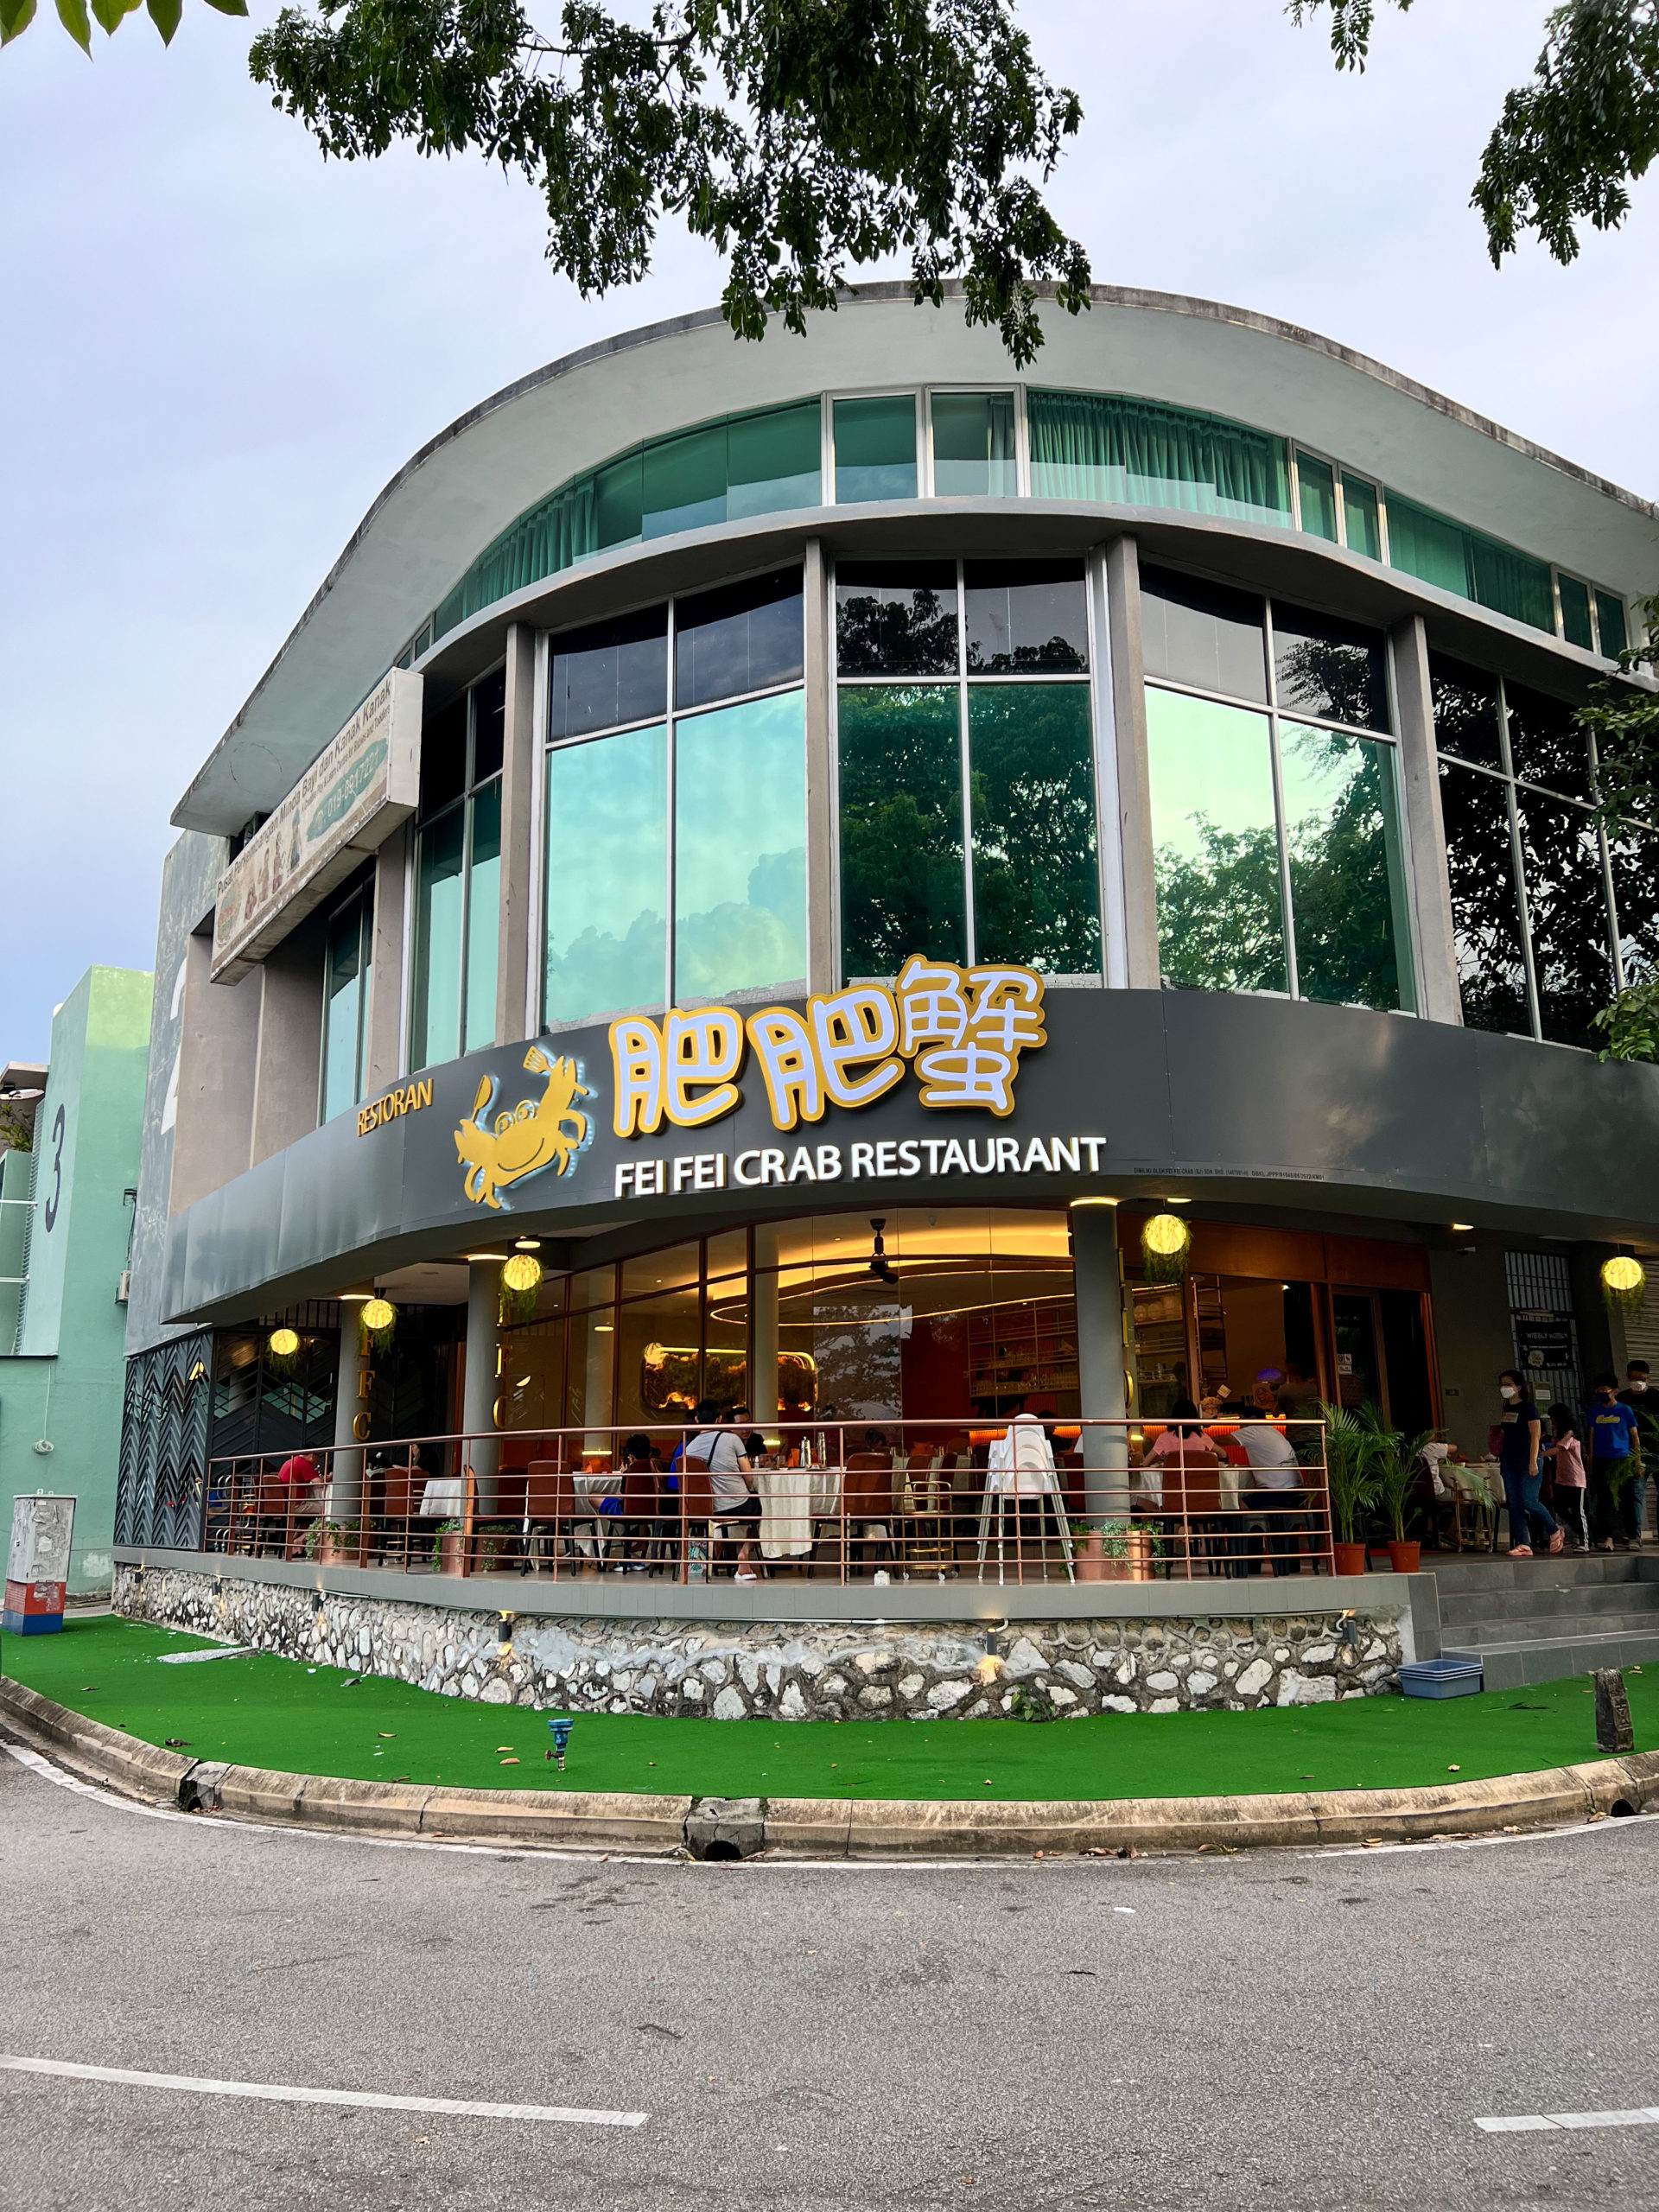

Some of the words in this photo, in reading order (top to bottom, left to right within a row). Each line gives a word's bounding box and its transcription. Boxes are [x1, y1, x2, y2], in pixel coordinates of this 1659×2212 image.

[218, 868, 233, 893] Pusat
[279, 791, 301, 823] Minda
[302, 768, 318, 796] Bayi
[319, 748, 334, 774] dan
[334, 715, 360, 755] Kanak
[362, 679, 391, 725] Kanak
[357, 1077, 434, 1137] RESTORAN
[610, 956, 1046, 1138] 肥肥蟹
[46, 1103, 66, 1234] 3
[614, 1159, 667, 1198] FEI
[674, 1152, 727, 1192] FEI
[734, 1143, 842, 1185] CRAB
[851, 1136, 1108, 1179] RESTAURANT
